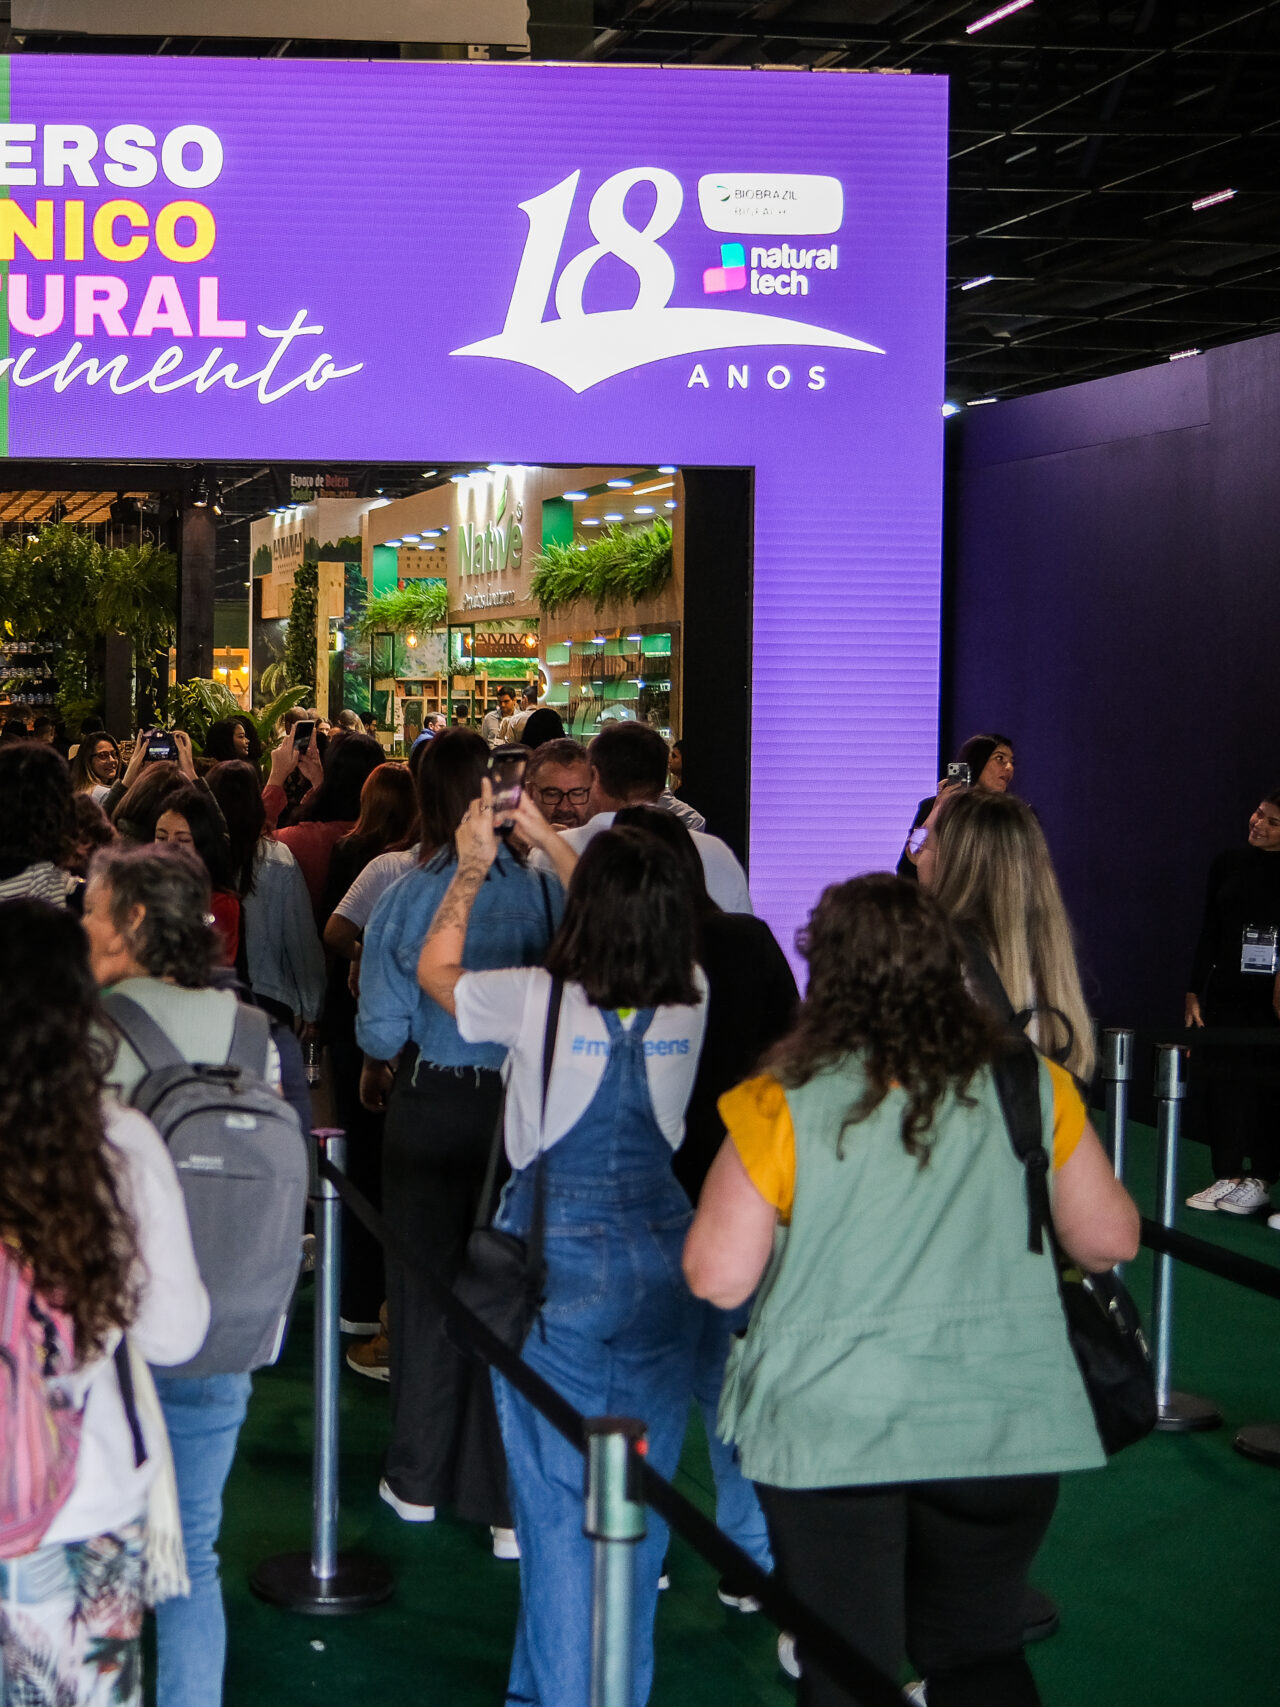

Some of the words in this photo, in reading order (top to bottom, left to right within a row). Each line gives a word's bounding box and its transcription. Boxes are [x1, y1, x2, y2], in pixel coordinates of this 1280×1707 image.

[734, 189, 798, 201] BIOBRAZIL
[501, 166, 684, 330] 18
[750, 243, 838, 270] natural
[750, 269, 809, 296] tech
[687, 364, 826, 390] ANOS
[315, 473, 325, 488] de
